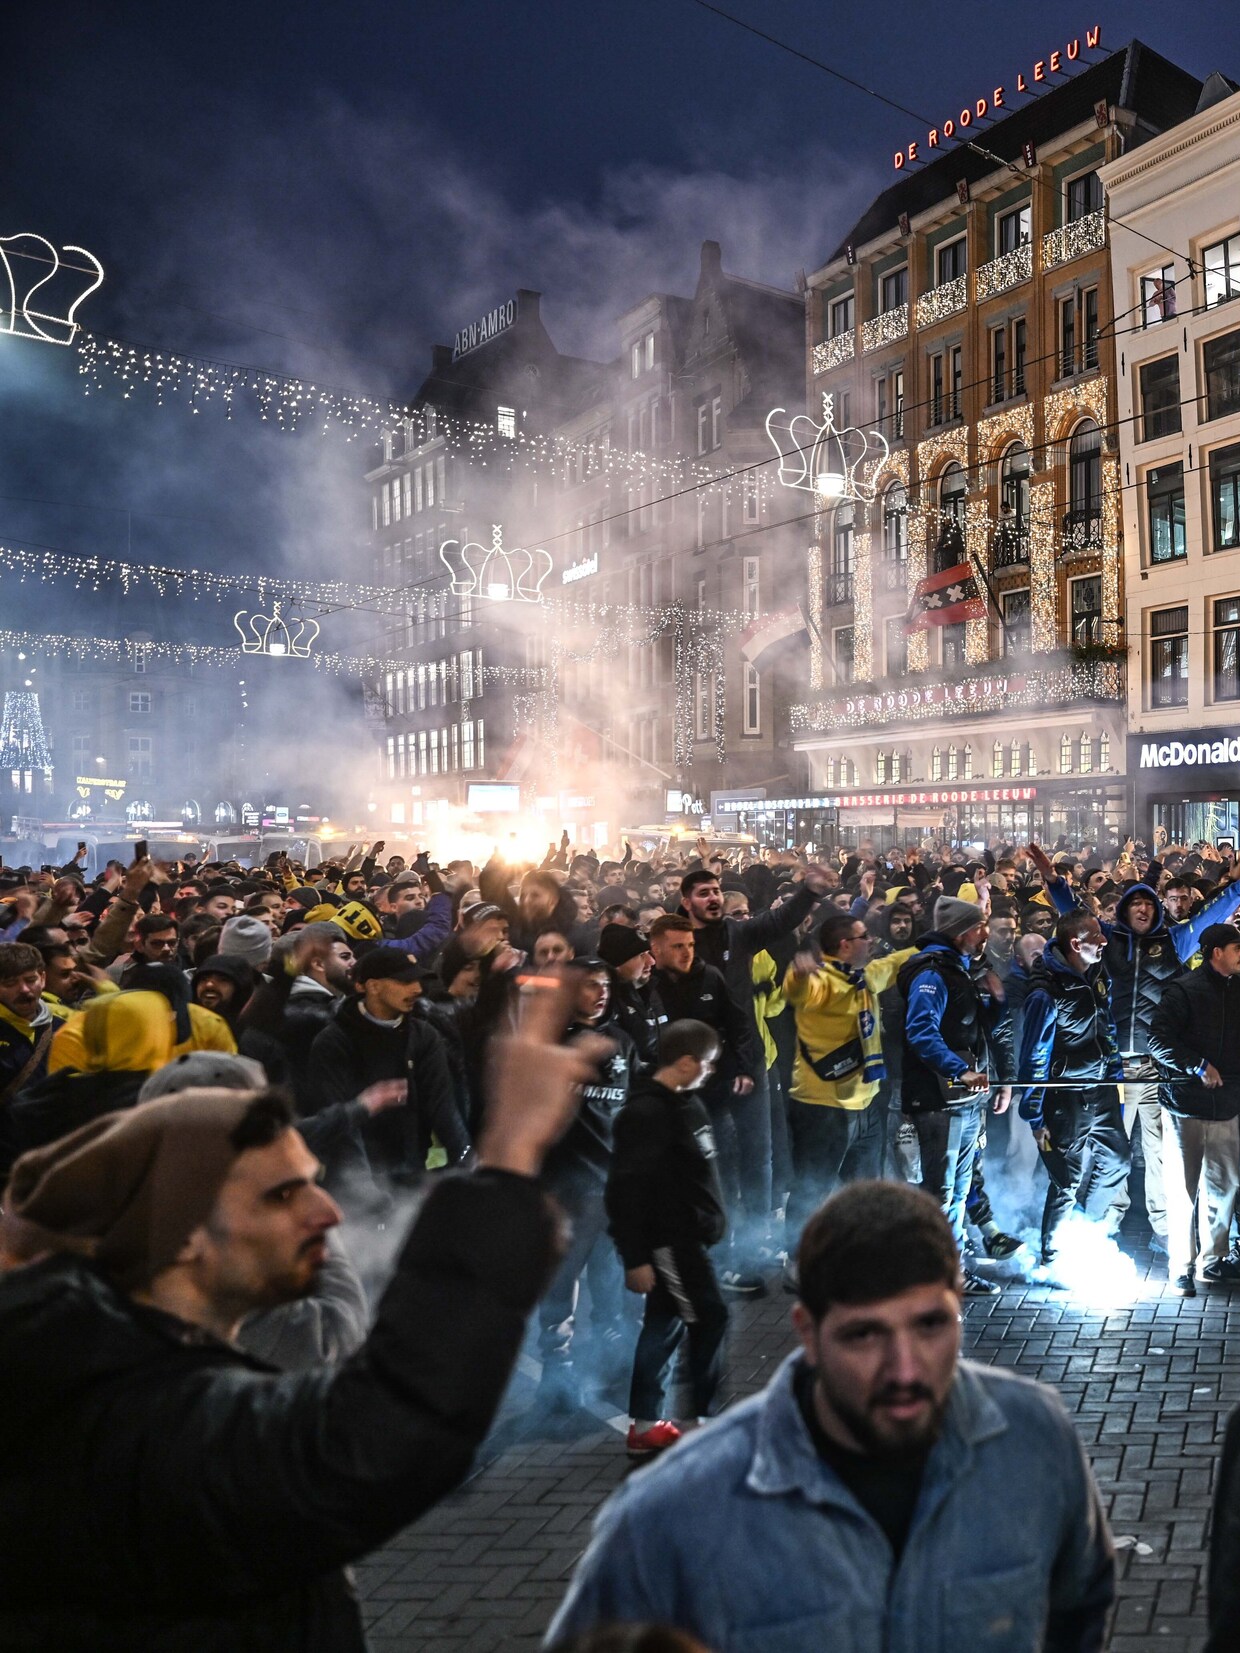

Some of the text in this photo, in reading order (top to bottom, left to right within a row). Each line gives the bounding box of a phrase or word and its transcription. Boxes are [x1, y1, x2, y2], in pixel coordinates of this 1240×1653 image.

[894, 25, 1102, 170] DE ROODE LEEUW
[846, 679, 1008, 714] DE ROODE LEEUW
[834, 793, 905, 806] BRASSERIE
[910, 792, 926, 804] DE
[932, 790, 977, 803] ROODE
[984, 787, 1032, 801] LEEUW
